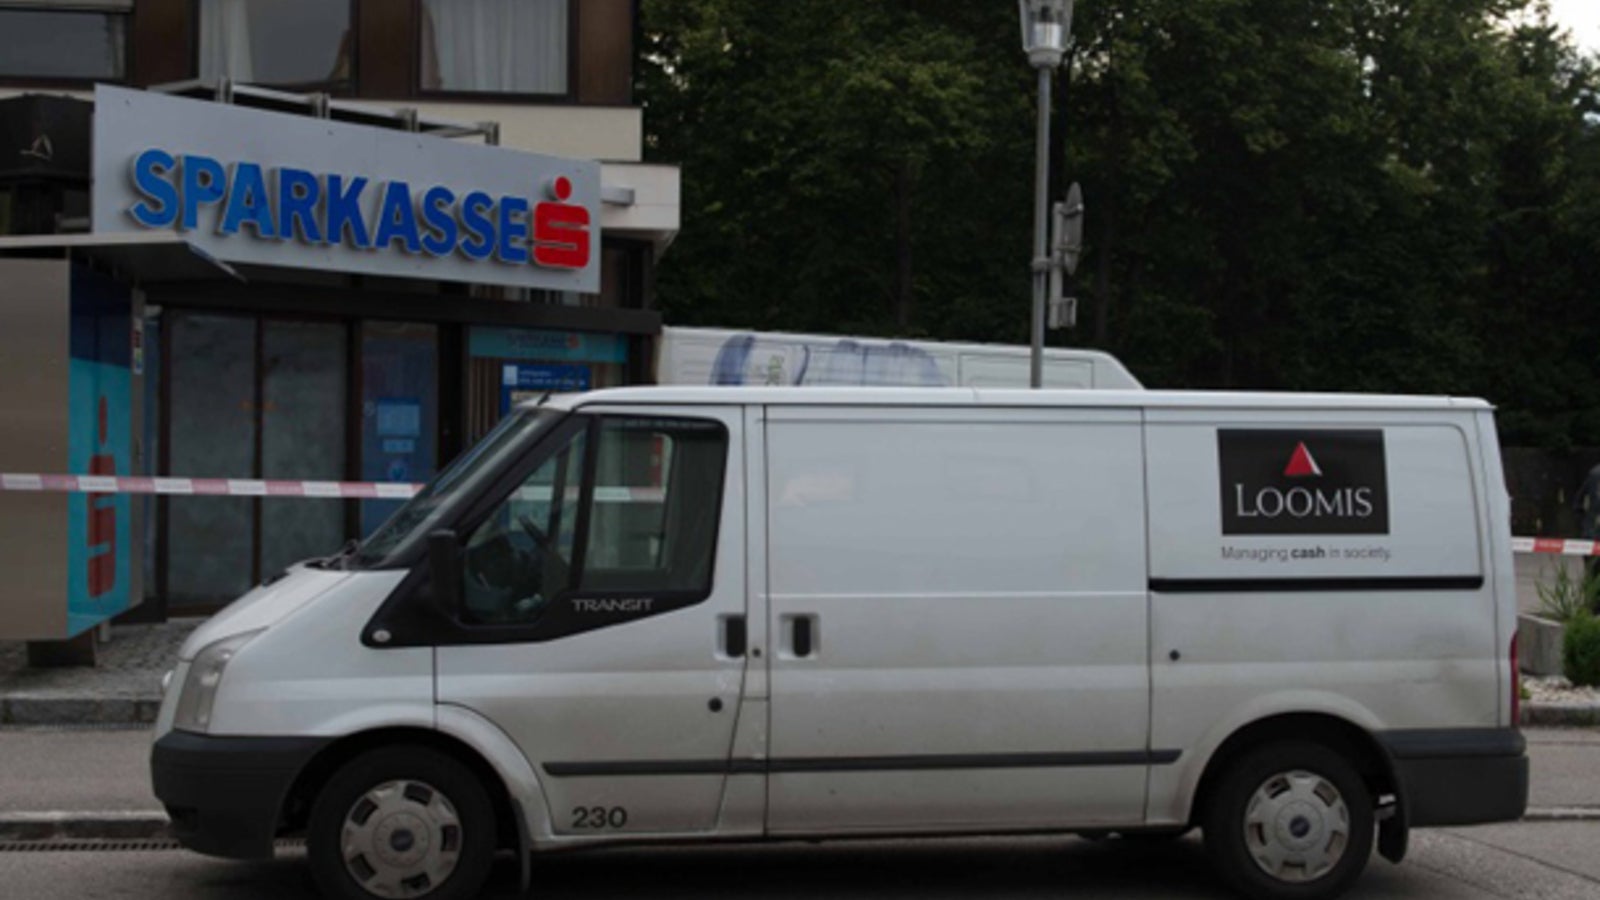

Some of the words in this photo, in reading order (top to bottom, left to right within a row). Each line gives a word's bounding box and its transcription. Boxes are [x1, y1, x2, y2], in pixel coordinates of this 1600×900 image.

[130, 149, 530, 265] SPARKASSE
[1235, 482, 1373, 518] LOOMIS
[1221, 546, 1290, 562] Managing
[1291, 546, 1326, 559] cash
[1329, 546, 1341, 559] in
[571, 598, 654, 612] TRANSIT
[572, 806, 628, 828] 230
